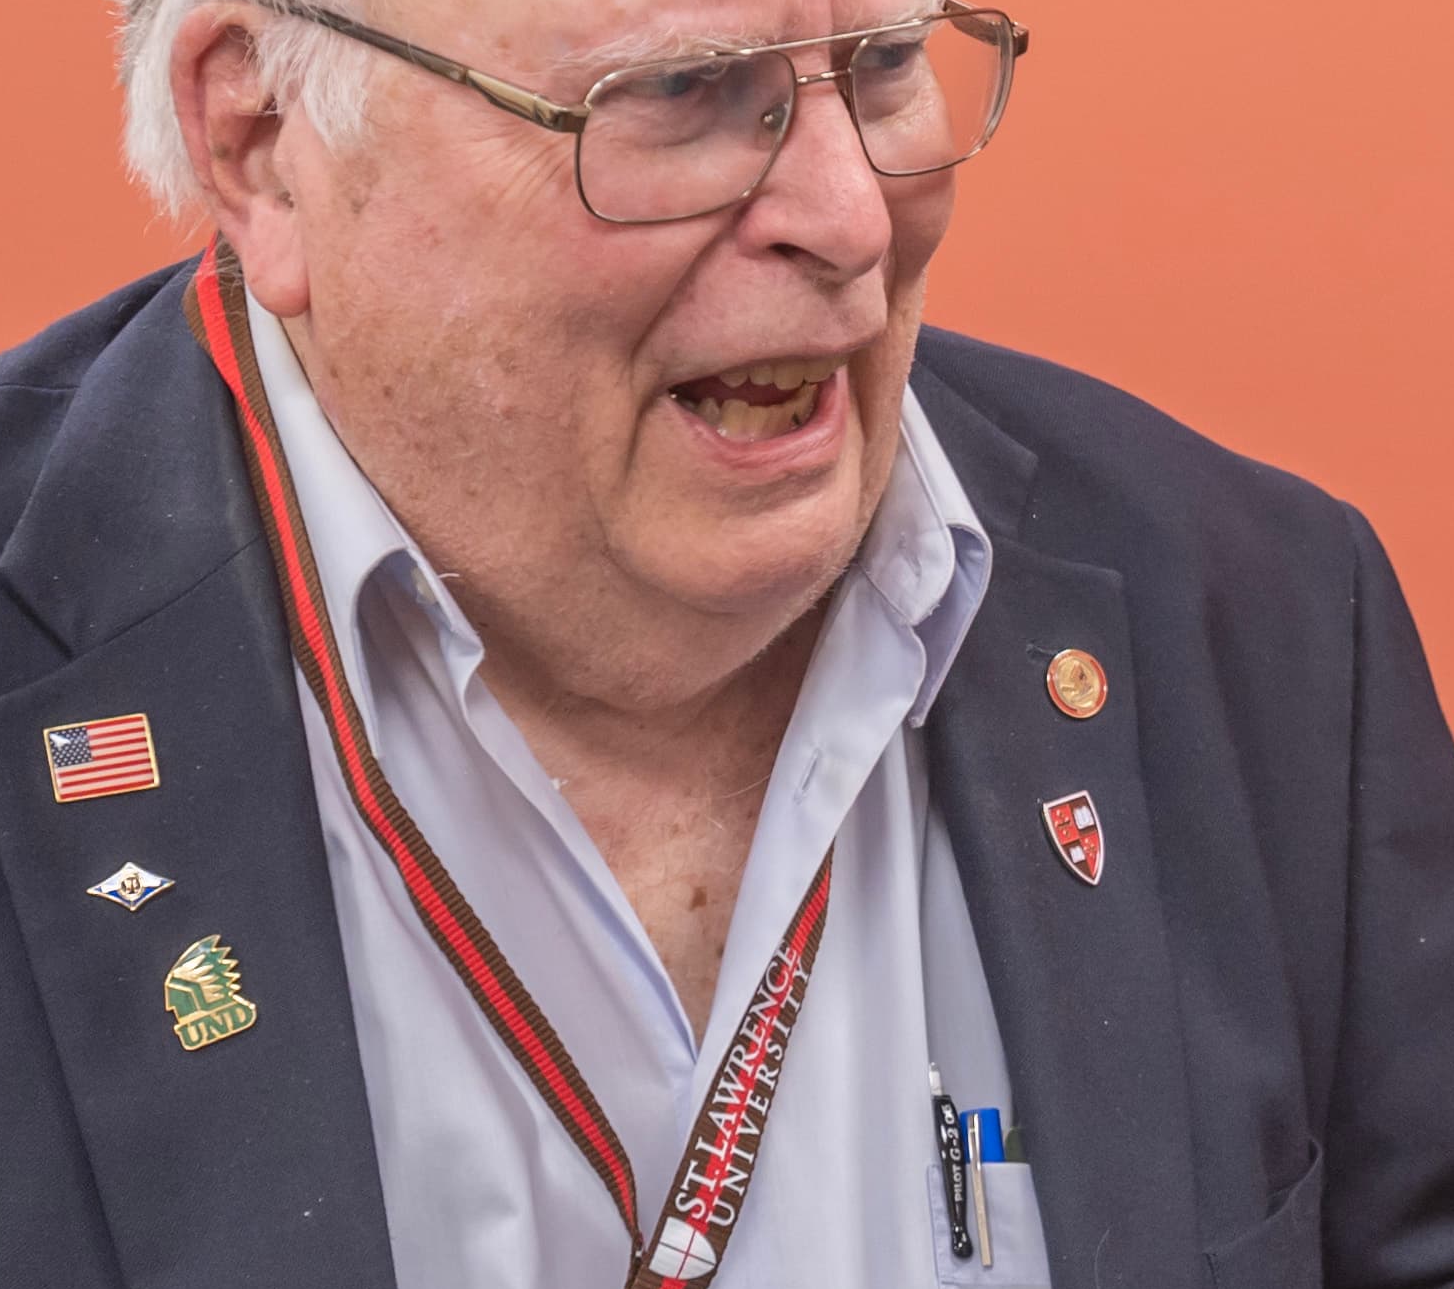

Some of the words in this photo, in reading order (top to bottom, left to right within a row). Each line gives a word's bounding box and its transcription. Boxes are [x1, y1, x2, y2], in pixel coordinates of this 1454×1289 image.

[180, 1003, 253, 1048] UND
[694, 944, 797, 1162] LAWRENCE
[705, 955, 810, 1227] UNIVERSITY
[952, 1163, 963, 1202] PILOT
